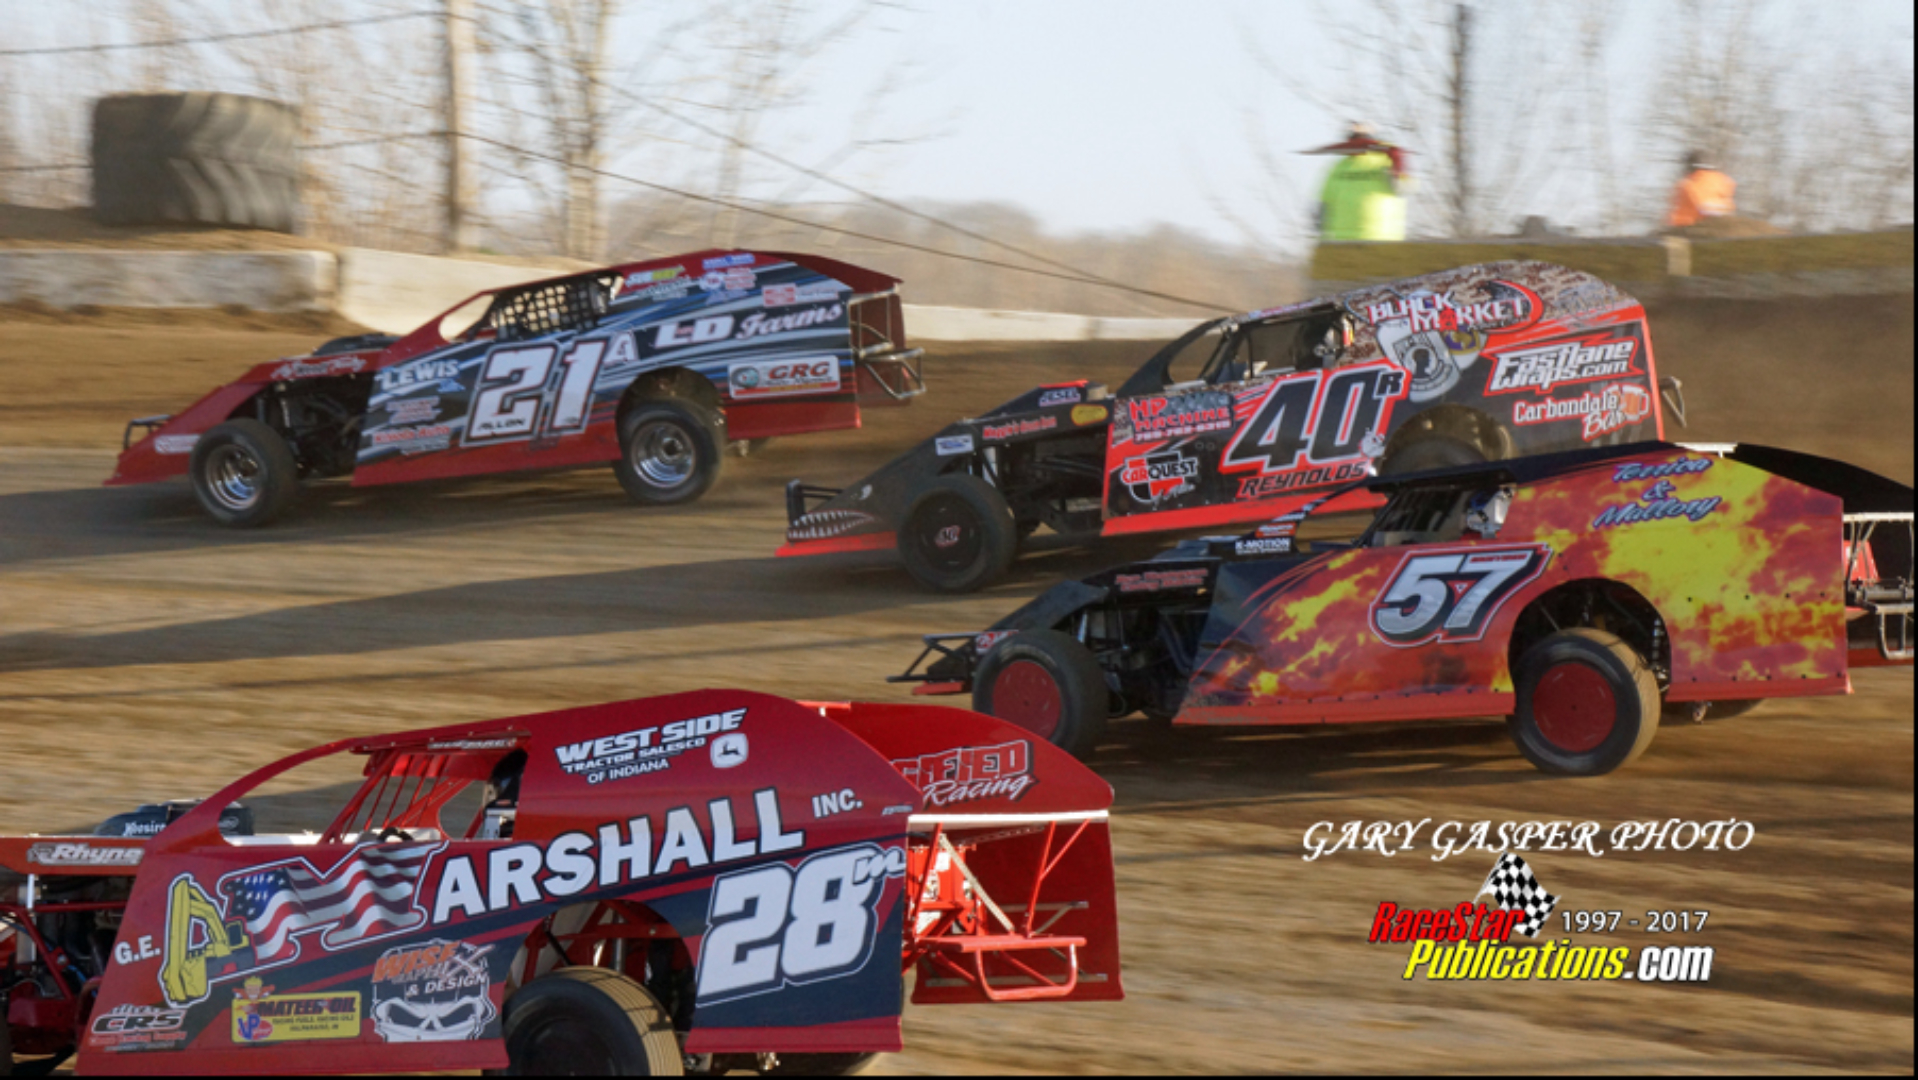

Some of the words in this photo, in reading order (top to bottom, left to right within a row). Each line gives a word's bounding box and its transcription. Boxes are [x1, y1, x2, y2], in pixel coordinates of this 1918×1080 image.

[736, 303, 844, 340] Farms
[380, 359, 460, 389] LEWIS
[768, 361, 830, 379] GRG
[1135, 407, 1230, 432] MACHINE
[1515, 392, 1619, 423] Carbondale
[1584, 411, 1626, 439] Bar
[1121, 461, 1197, 484] CARQUEST
[1241, 462, 1367, 497] REYNOLDS
[1642, 480, 1676, 500] &
[1593, 497, 1722, 528] Mallory
[1375, 549, 1536, 636] 57
[555, 727, 658, 765] WEST
[661, 708, 748, 743] SIDE
[562, 752, 635, 773] TRACTOR
[587, 770, 607, 785] OF
[609, 758, 669, 780] INDIANA
[922, 773, 1033, 806] Racing
[115, 935, 161, 967] G.E.
[812, 787, 862, 818] INC.
[371, 940, 461, 983] WISE
[405, 983, 419, 998] &
[424, 973, 487, 994] DESIGN
[258, 998, 325, 1017] MATEER
[328, 996, 356, 1013] OIL
[91, 1009, 188, 1034] CRS
[237, 1013, 261, 1040] VP
